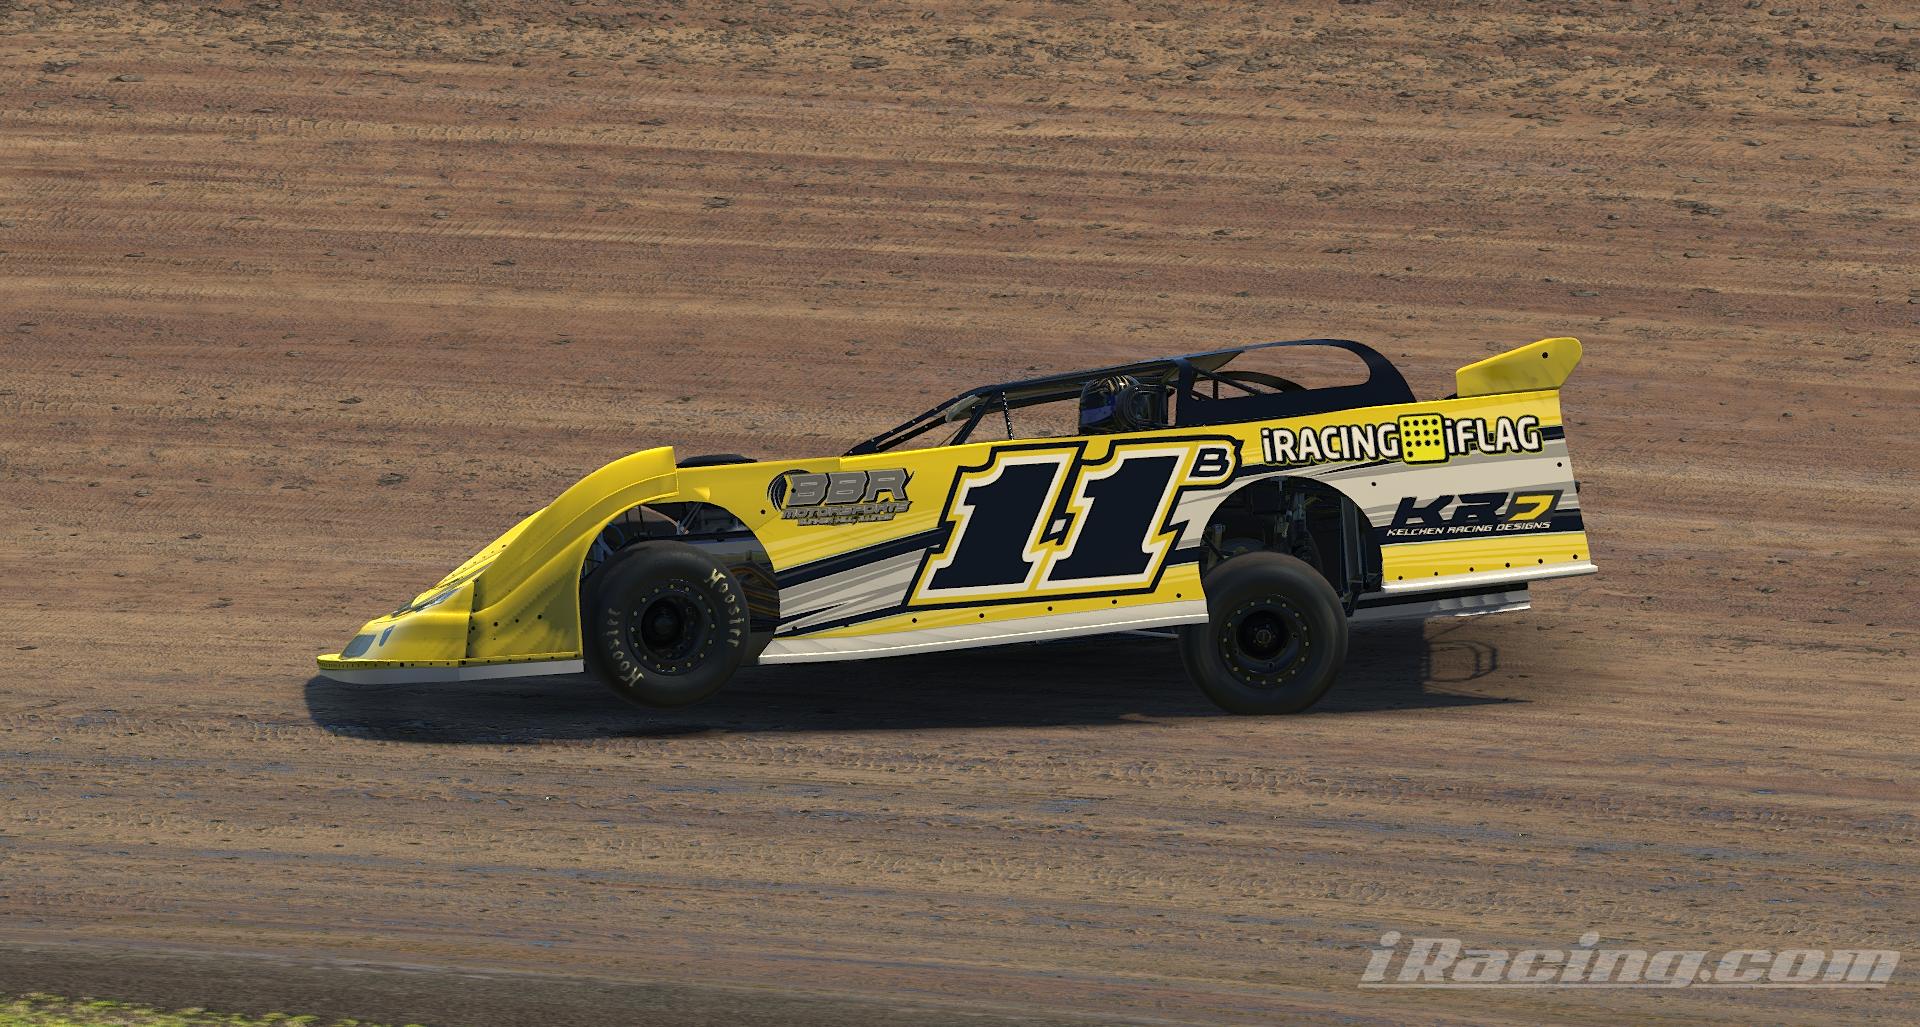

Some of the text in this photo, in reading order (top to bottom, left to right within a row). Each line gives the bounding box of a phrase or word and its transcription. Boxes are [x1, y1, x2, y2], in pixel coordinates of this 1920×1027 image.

[1261, 416, 1542, 463] iRACING iFLAG
[787, 468, 908, 507] BBR
[783, 500, 911, 519] MOTORSPORTS
[1386, 521, 1552, 537] KELCHEN RACING DESIGNS
